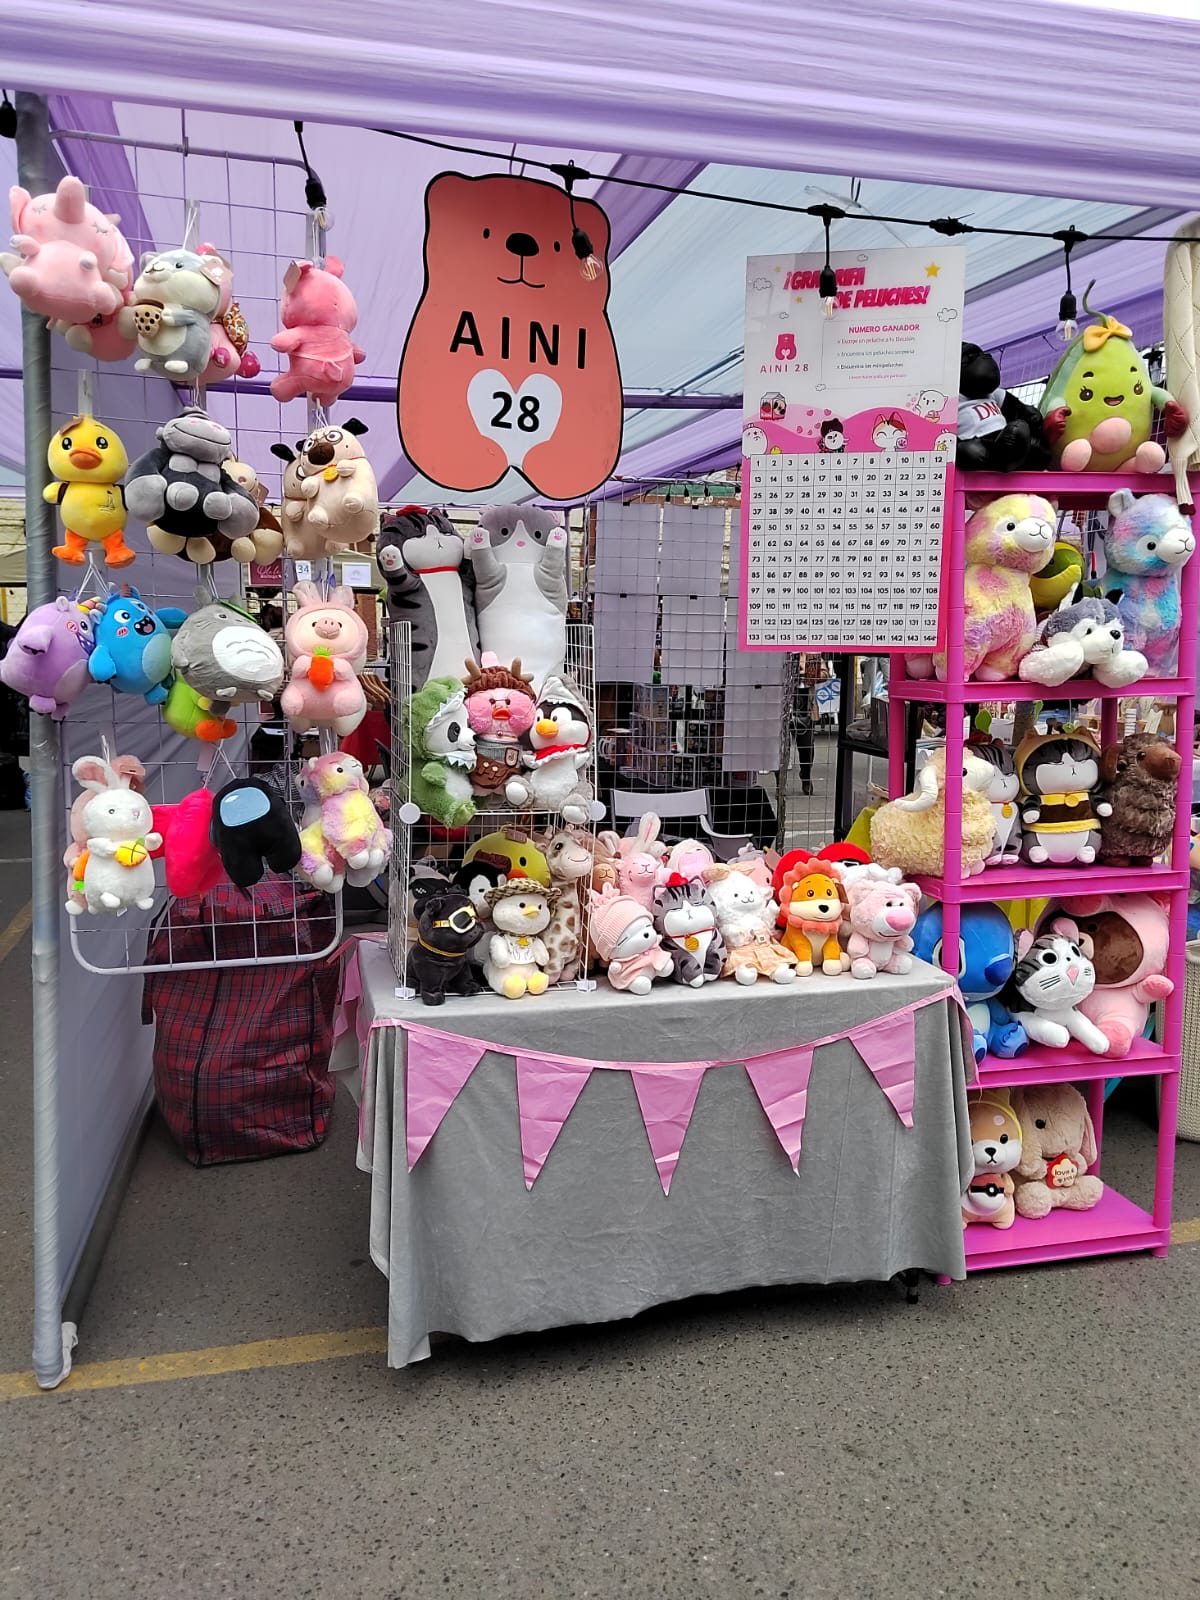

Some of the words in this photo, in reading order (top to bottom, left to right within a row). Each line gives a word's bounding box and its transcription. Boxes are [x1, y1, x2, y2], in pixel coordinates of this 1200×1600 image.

[783, 270, 821, 290] ¡GRA
[854, 285, 930, 308] PELUCHES!
[848, 326, 880, 334] NUMERO
[882, 324, 920, 332] GANADOR
[449, 311, 587, 369] AINI
[760, 364, 788, 374] AINI
[794, 364, 809, 372] 28
[490, 391, 541, 432] 28
[298, 564, 310, 574] 34
